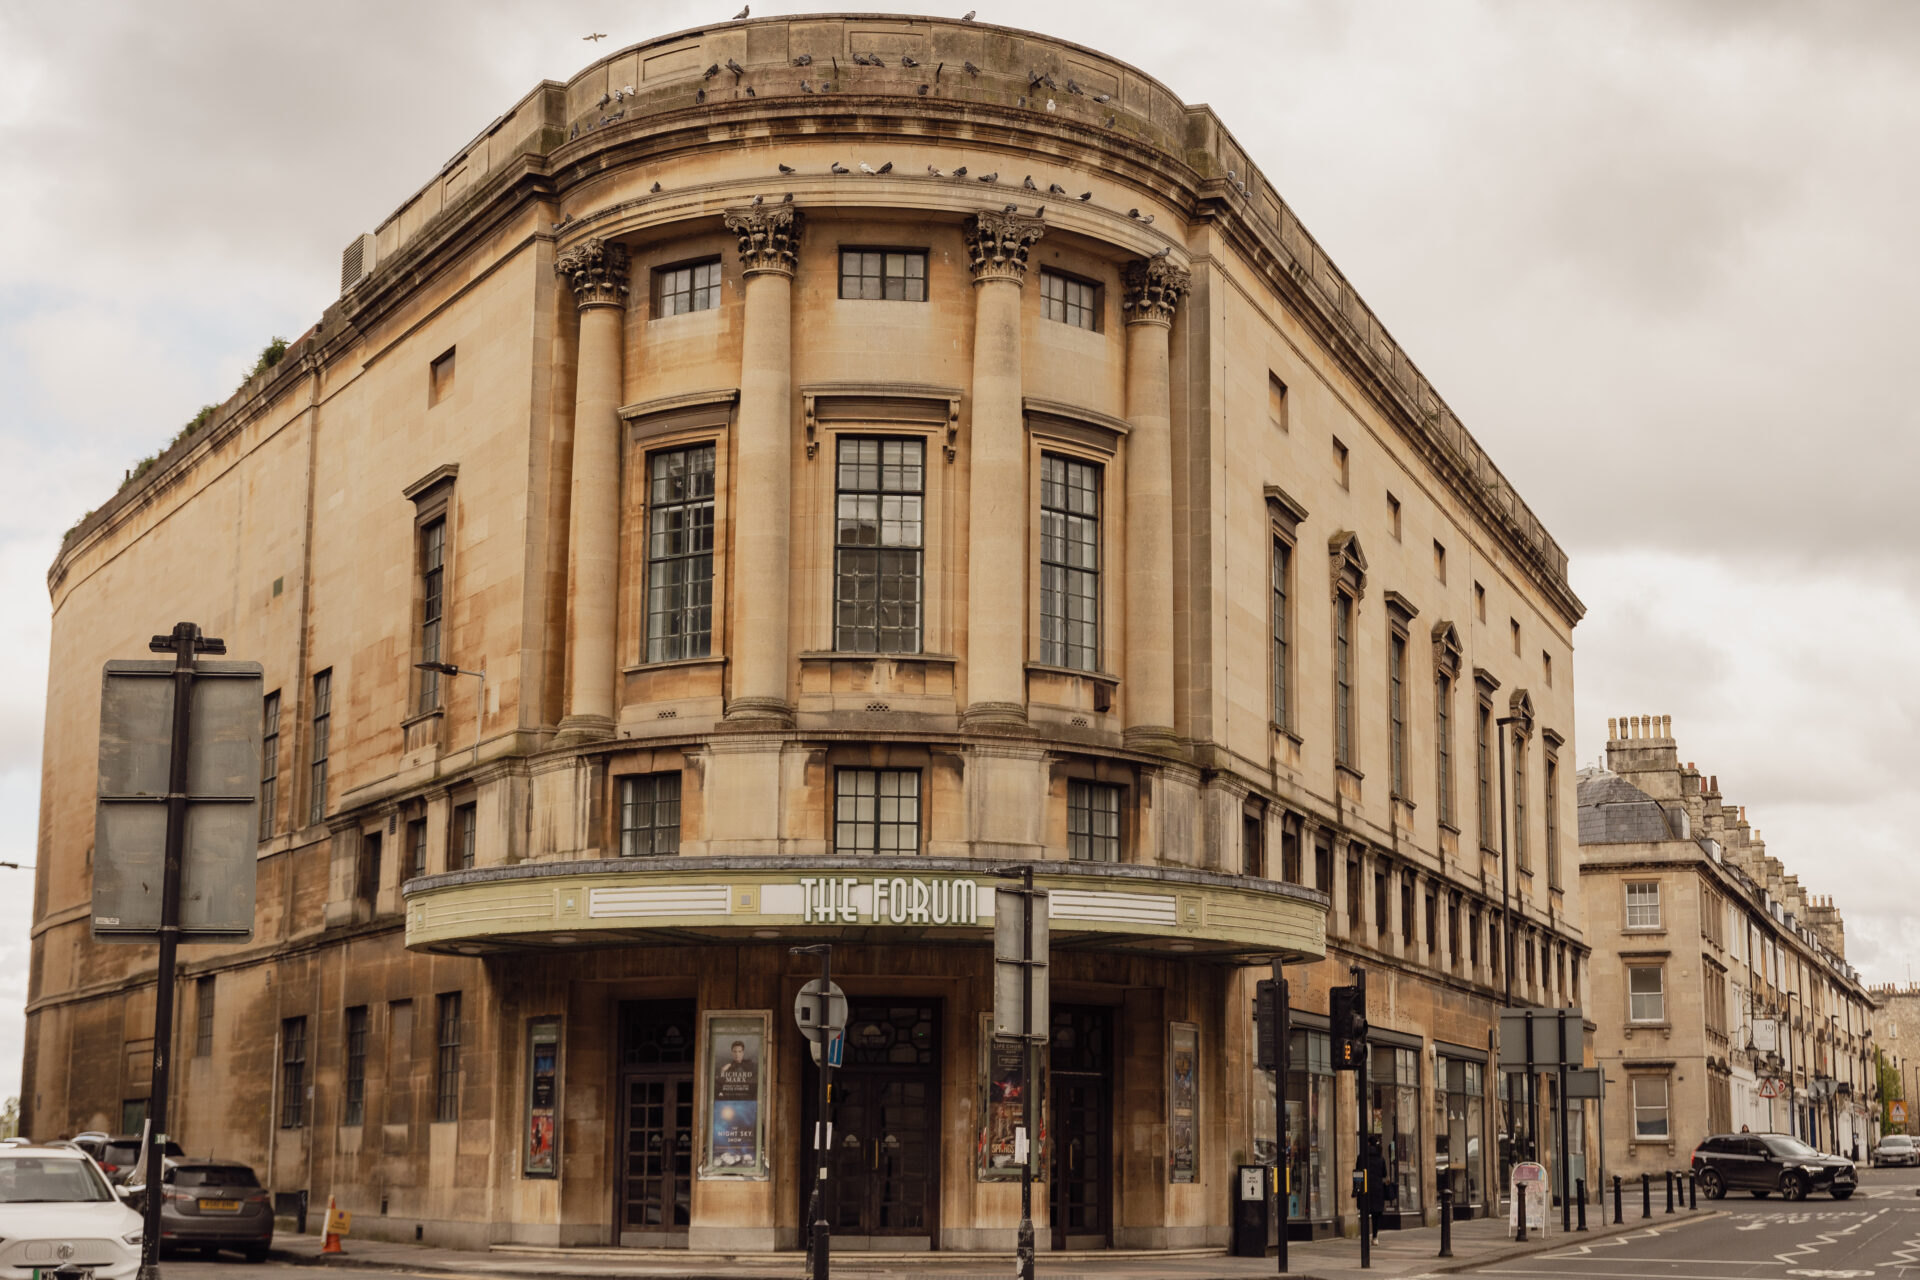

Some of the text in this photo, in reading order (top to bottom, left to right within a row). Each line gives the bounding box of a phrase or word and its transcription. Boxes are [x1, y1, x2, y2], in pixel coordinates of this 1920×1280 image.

[801, 877, 977, 924] THE FORUM
[1764, 1023, 1774, 1031] 19
[58, 1245, 74, 1259] MG
